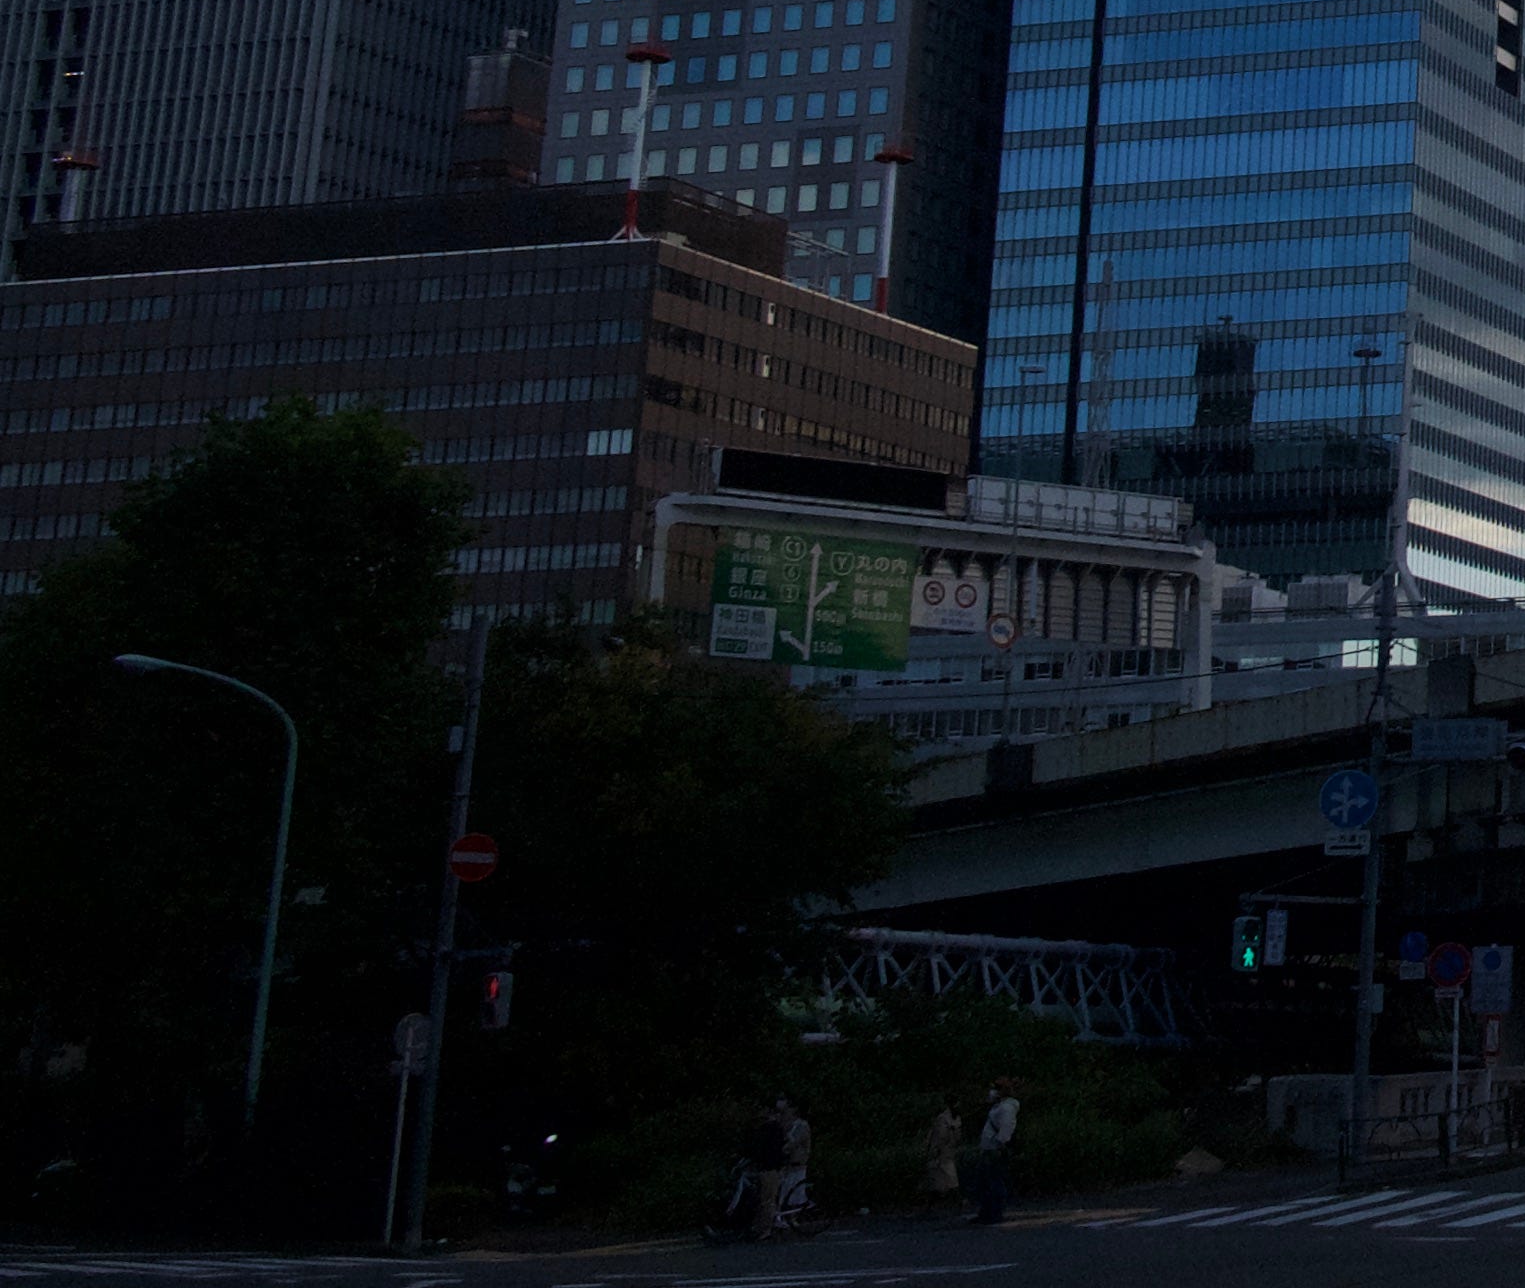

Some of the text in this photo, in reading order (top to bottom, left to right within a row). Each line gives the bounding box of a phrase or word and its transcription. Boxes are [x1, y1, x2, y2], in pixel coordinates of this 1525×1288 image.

[855, 554, 908, 575] 丸の内
[728, 585, 768, 601] Ginza
